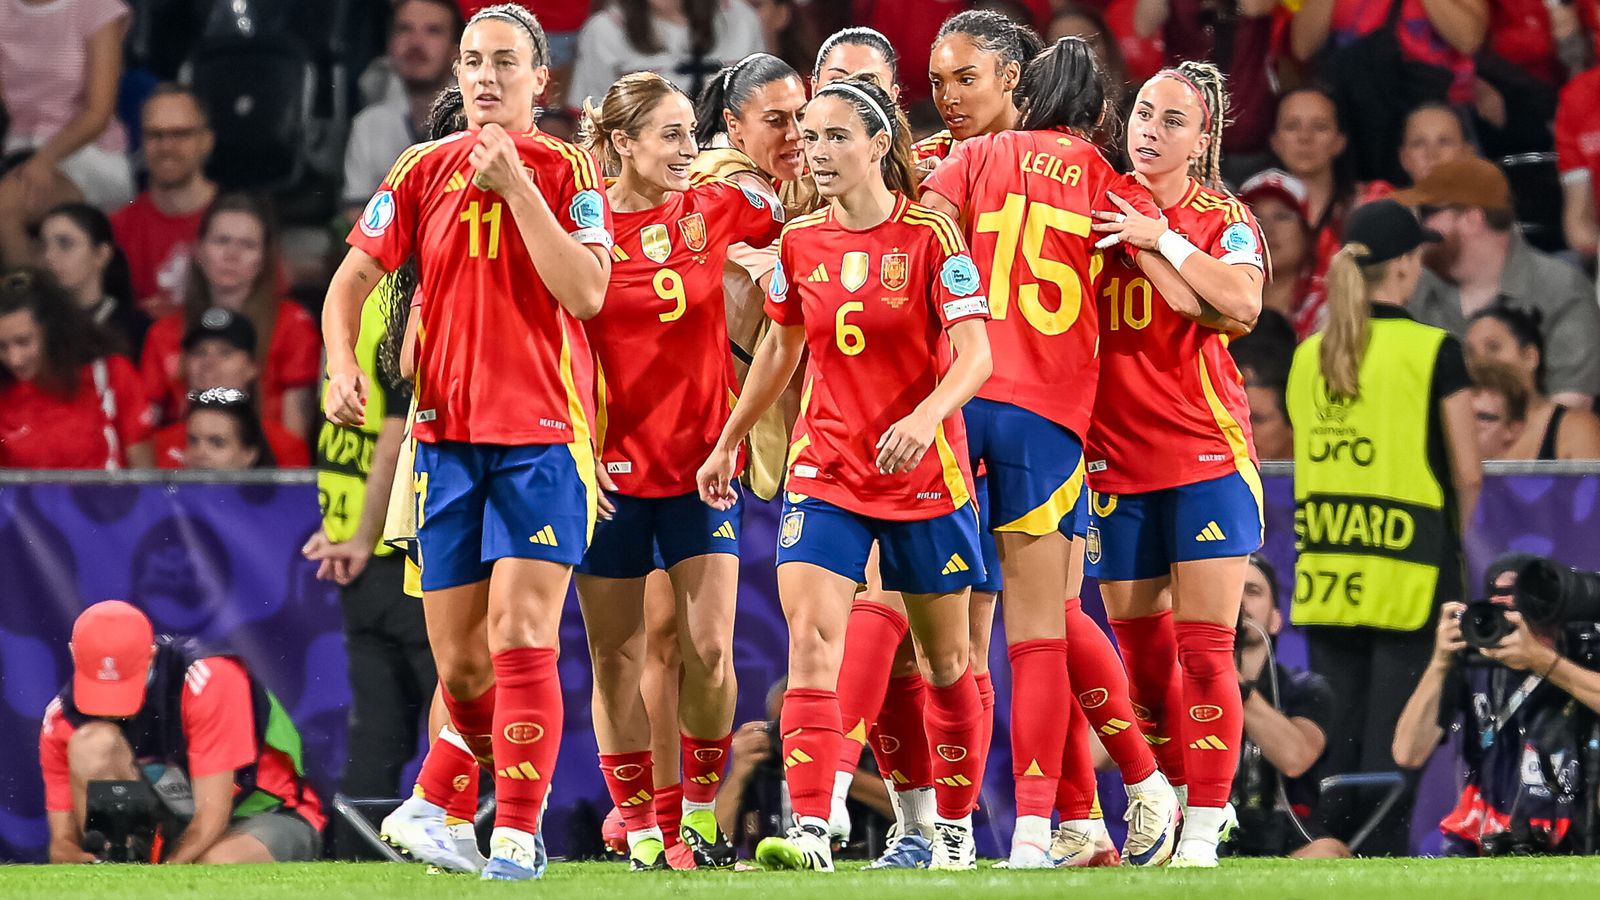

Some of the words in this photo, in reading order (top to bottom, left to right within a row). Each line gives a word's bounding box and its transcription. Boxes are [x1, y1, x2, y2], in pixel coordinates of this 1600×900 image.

[1021, 150, 1082, 187] LEILA
[460, 201, 502, 259] 11
[976, 192, 1093, 336] 15
[652, 267, 687, 323] 9
[1103, 277, 1152, 330] 10
[835, 301, 866, 356] 6
